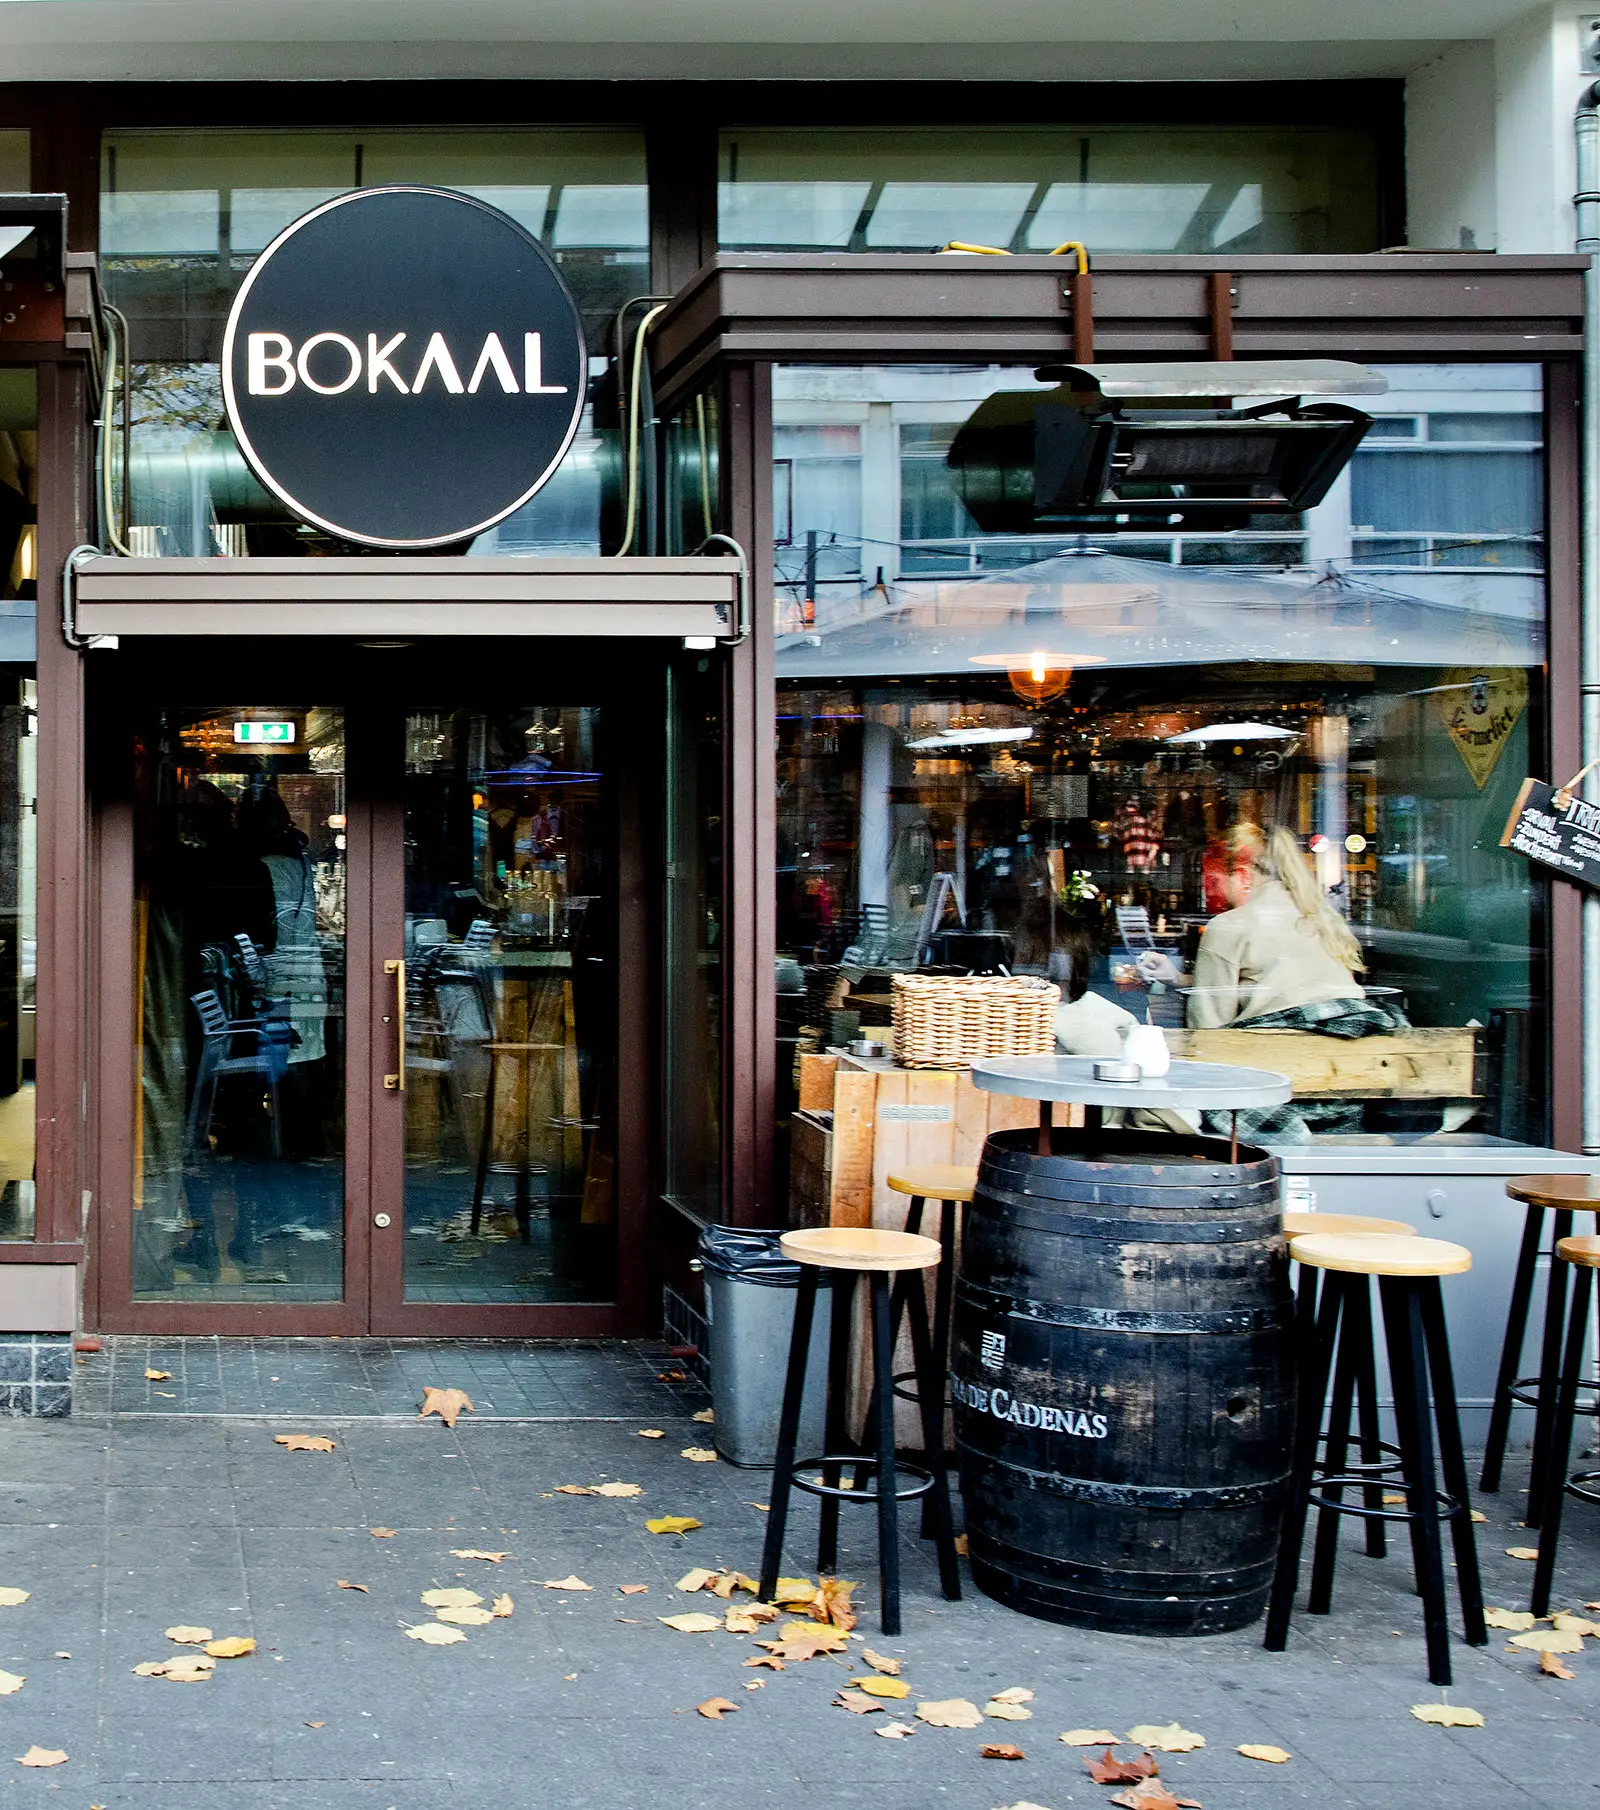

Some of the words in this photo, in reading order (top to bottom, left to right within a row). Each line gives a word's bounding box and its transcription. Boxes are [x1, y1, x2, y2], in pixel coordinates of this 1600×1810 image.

[248, 332, 568, 395] BOKAAL
[967, 1384, 989, 1413] DE
[990, 1388, 1108, 1439] CADENAS
